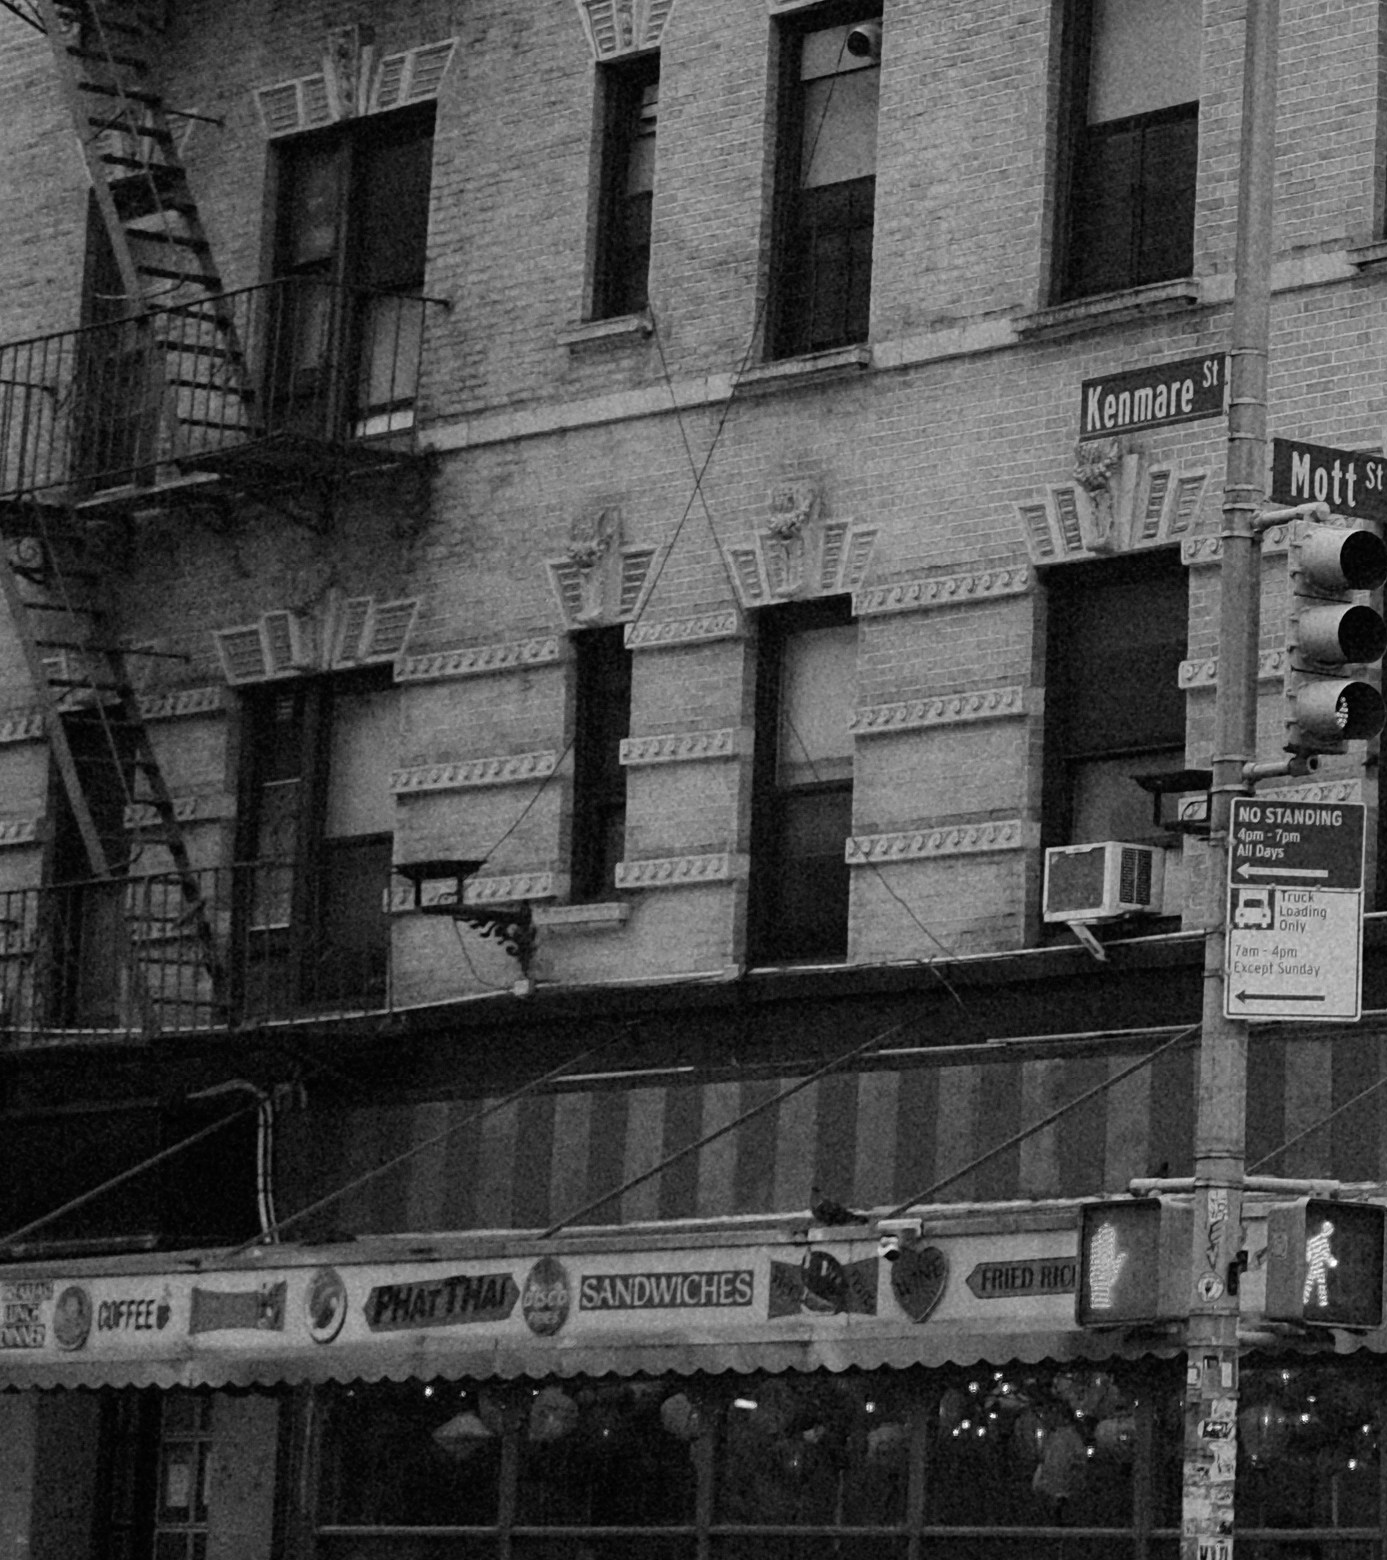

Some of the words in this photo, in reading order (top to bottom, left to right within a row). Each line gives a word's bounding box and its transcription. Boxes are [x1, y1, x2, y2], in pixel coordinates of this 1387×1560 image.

[1086, 378, 1194, 431] Kenmare
[1202, 360, 1219, 388] St
[1291, 450, 1357, 508] Mott
[1365, 461, 1384, 491] St
[1238, 806, 1261, 823] NO
[1265, 807, 1343, 827] STANDING
[1237, 827, 1264, 843] 4pm
[1275, 828, 1300, 844] 7pm
[1236, 843, 1253, 858] All
[1255, 844, 1285, 861] Days
[1279, 890, 1315, 904] Truck
[1279, 905, 1328, 920] Loading
[1279, 919, 1307, 934] Only
[1234, 944, 1260, 957] 7am
[1271, 945, 1298, 960] 4pm
[1233, 961, 1274, 977] Except
[1278, 962, 1321, 978] Sunday
[980, 1264, 1034, 1292] FRIED
[1041, 1262, 1077, 1289] RIC
[374, 1285, 442, 1325] PHAT
[443, 1274, 507, 1314] THAI
[581, 1272, 752, 1308] SANDWICHES
[98, 1299, 155, 1331] COFFEE
